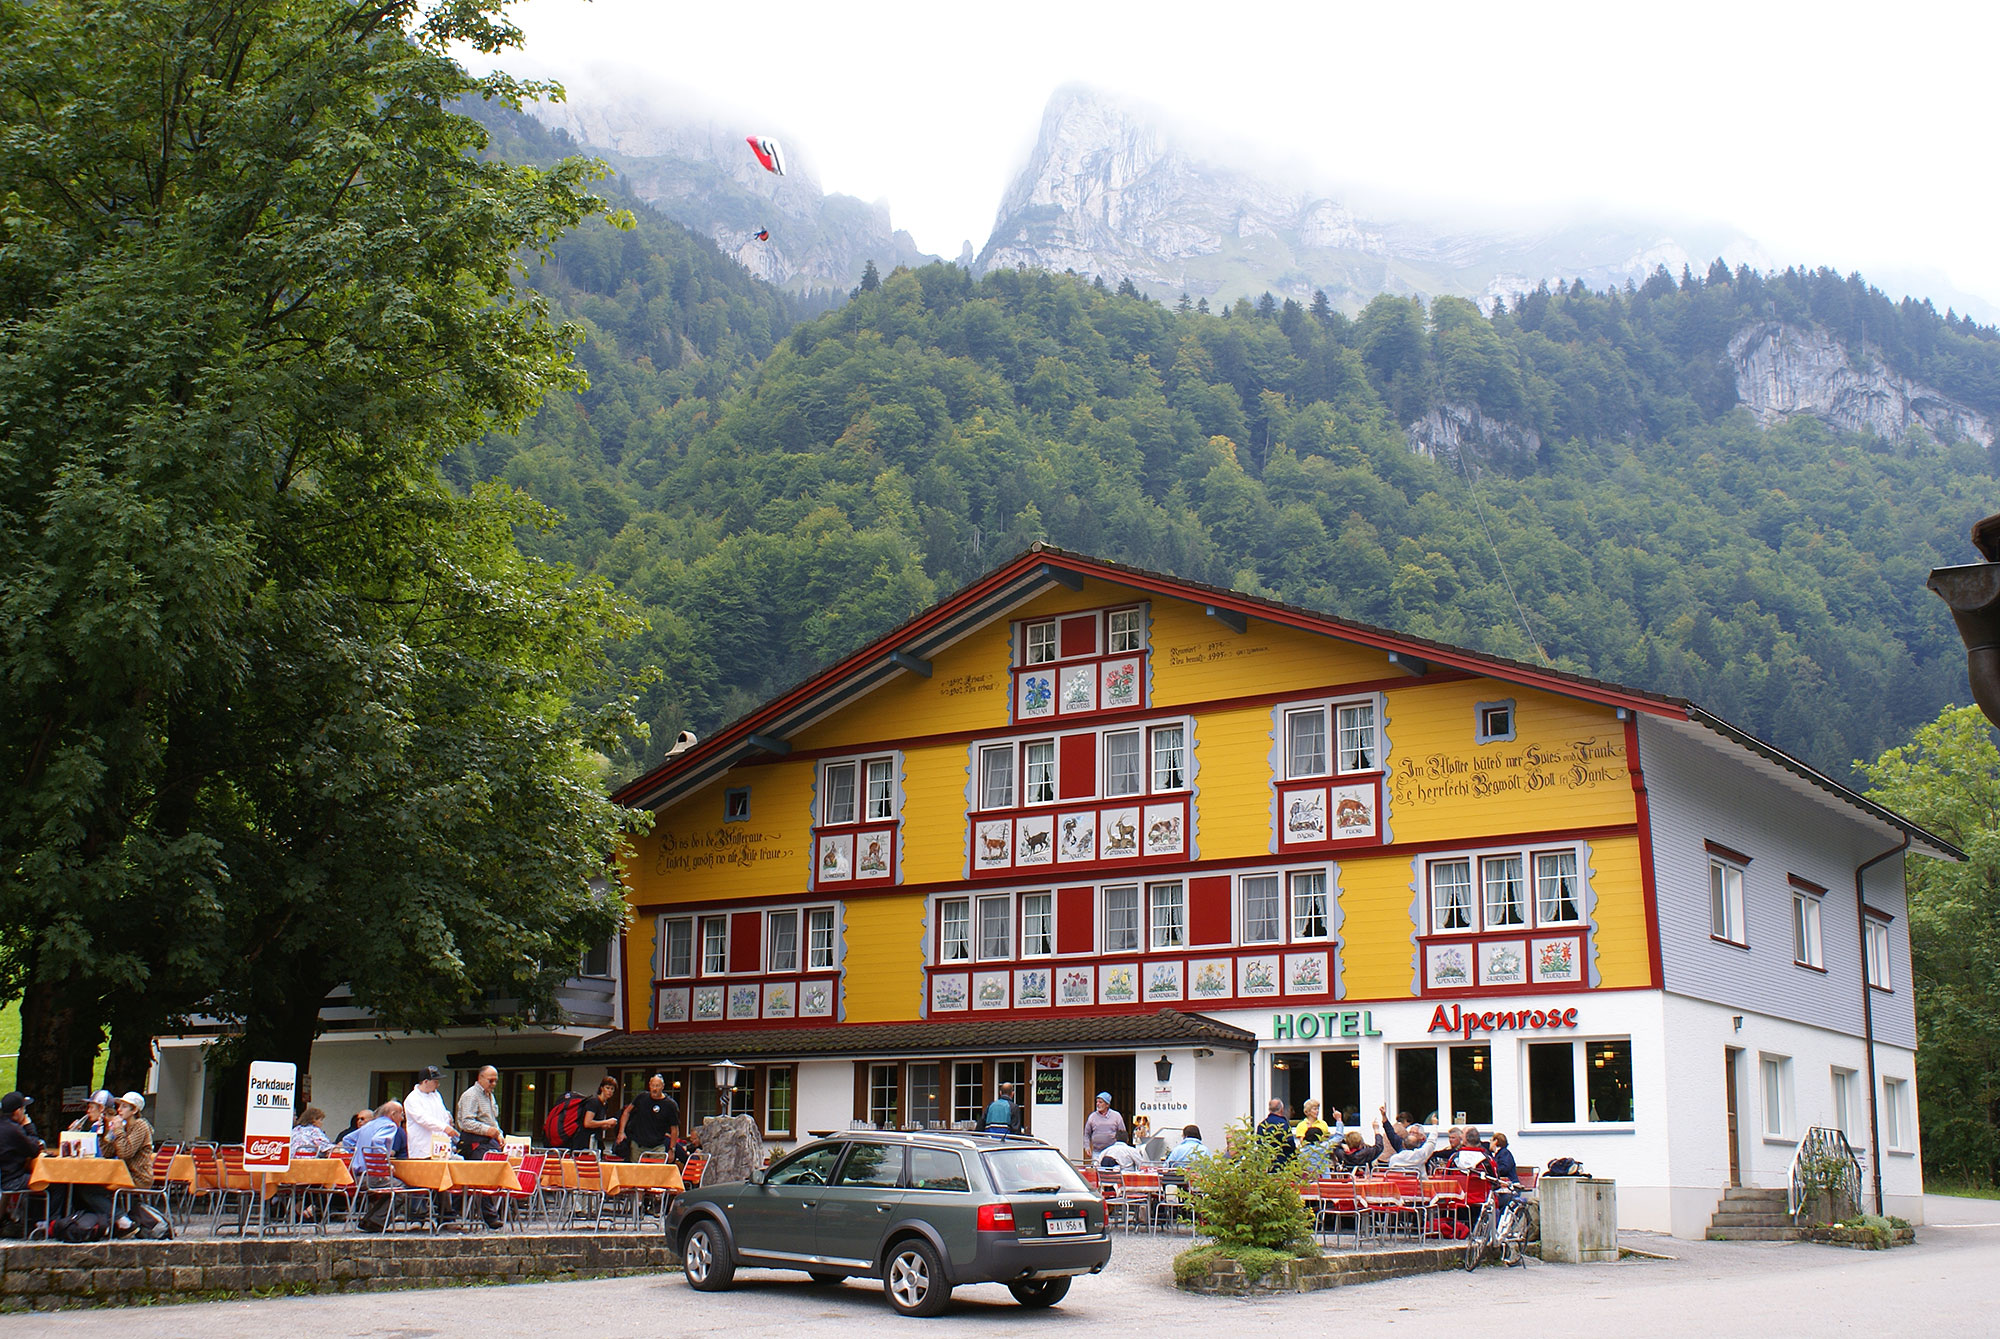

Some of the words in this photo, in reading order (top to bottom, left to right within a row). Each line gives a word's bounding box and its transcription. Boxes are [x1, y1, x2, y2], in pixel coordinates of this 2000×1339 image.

[1398, 757, 1424, 778] Im
[1523, 743, 1561, 767] Spies
[1566, 736, 1618, 764] Trank
[1568, 763, 1616, 789] Dank
[1273, 1010, 1383, 1040] HOTEL
[1427, 1003, 1578, 1041] Alpenrose
[250, 1077, 294, 1091] Parkdauer
[256, 1094, 268, 1106] 90
[272, 1094, 290, 1106] Min.
[1140, 1101, 1188, 1111] Gaststube
